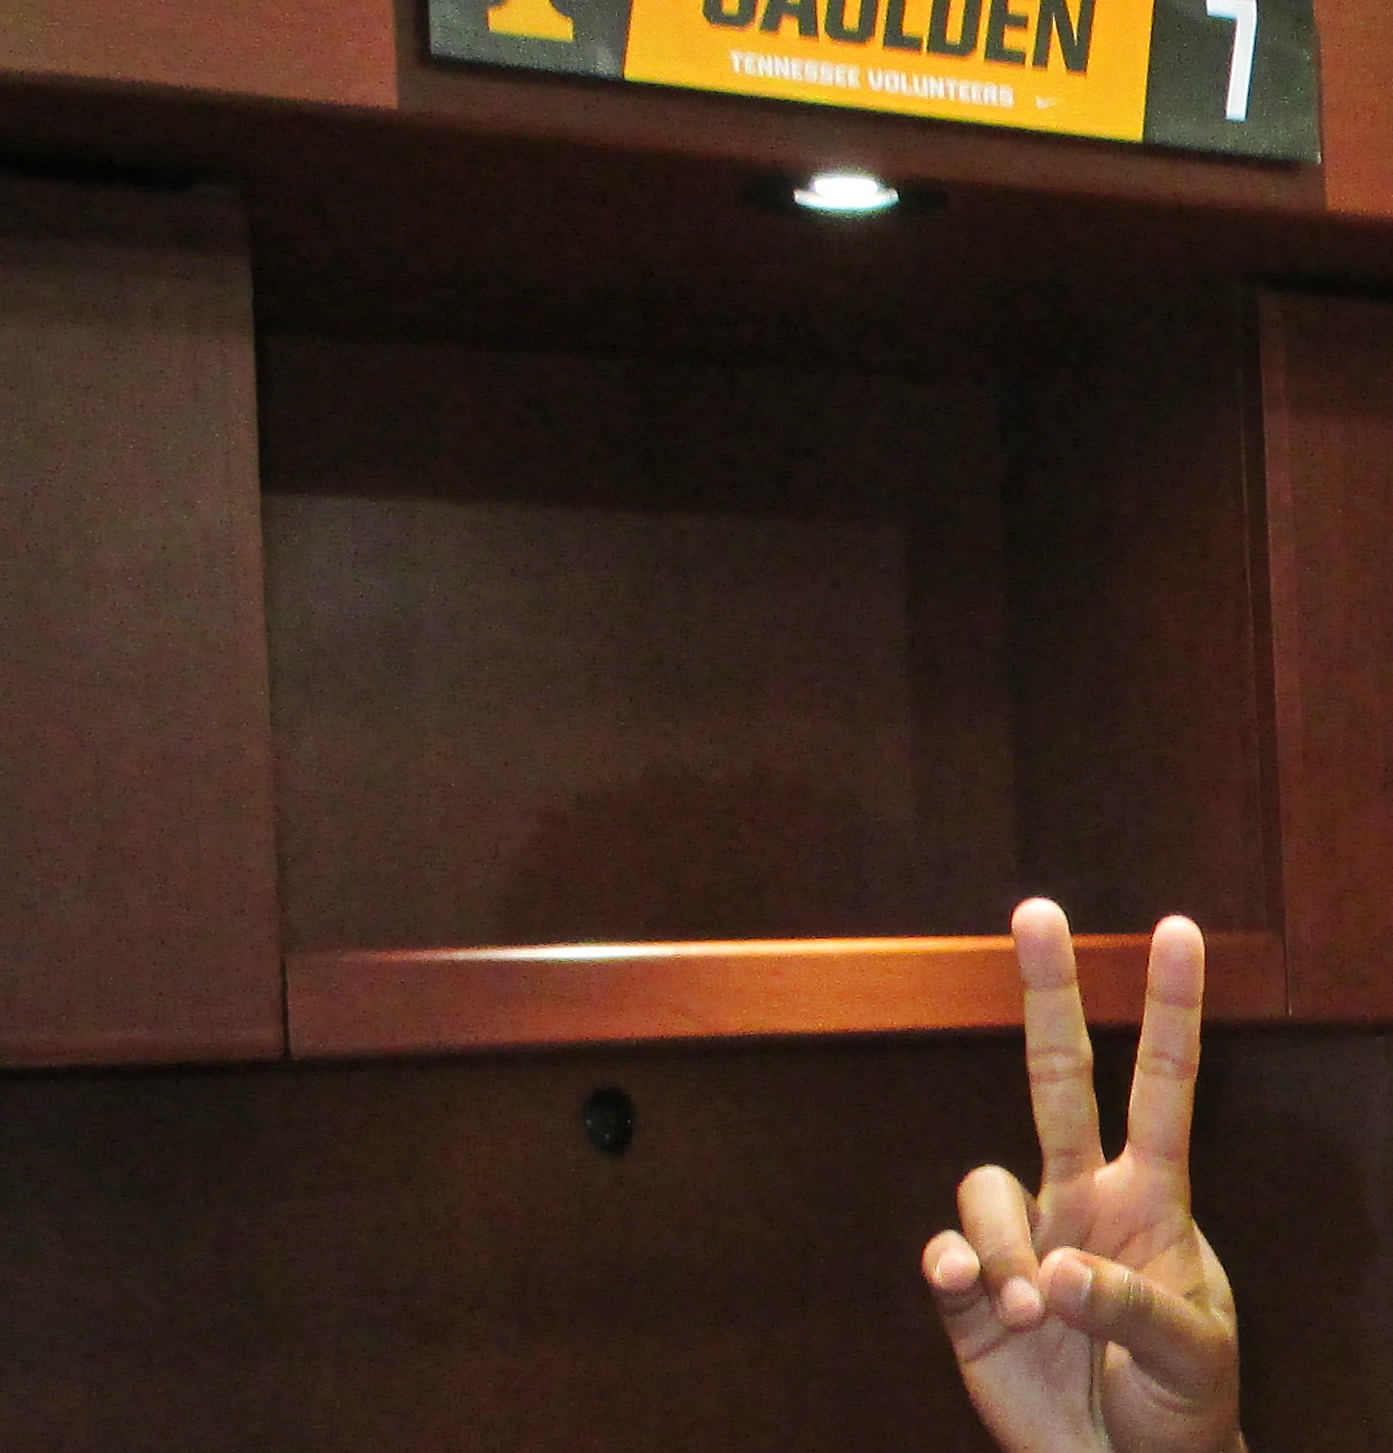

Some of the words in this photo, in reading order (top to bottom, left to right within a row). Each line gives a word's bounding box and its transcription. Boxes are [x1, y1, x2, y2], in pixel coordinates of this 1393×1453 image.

[701, 0, 1095, 74] LDEN
[1205, 0, 1258, 121] 7
[730, 50, 861, 89] TENNESSEE
[868, 68, 1015, 107] VOLUNTEERS
